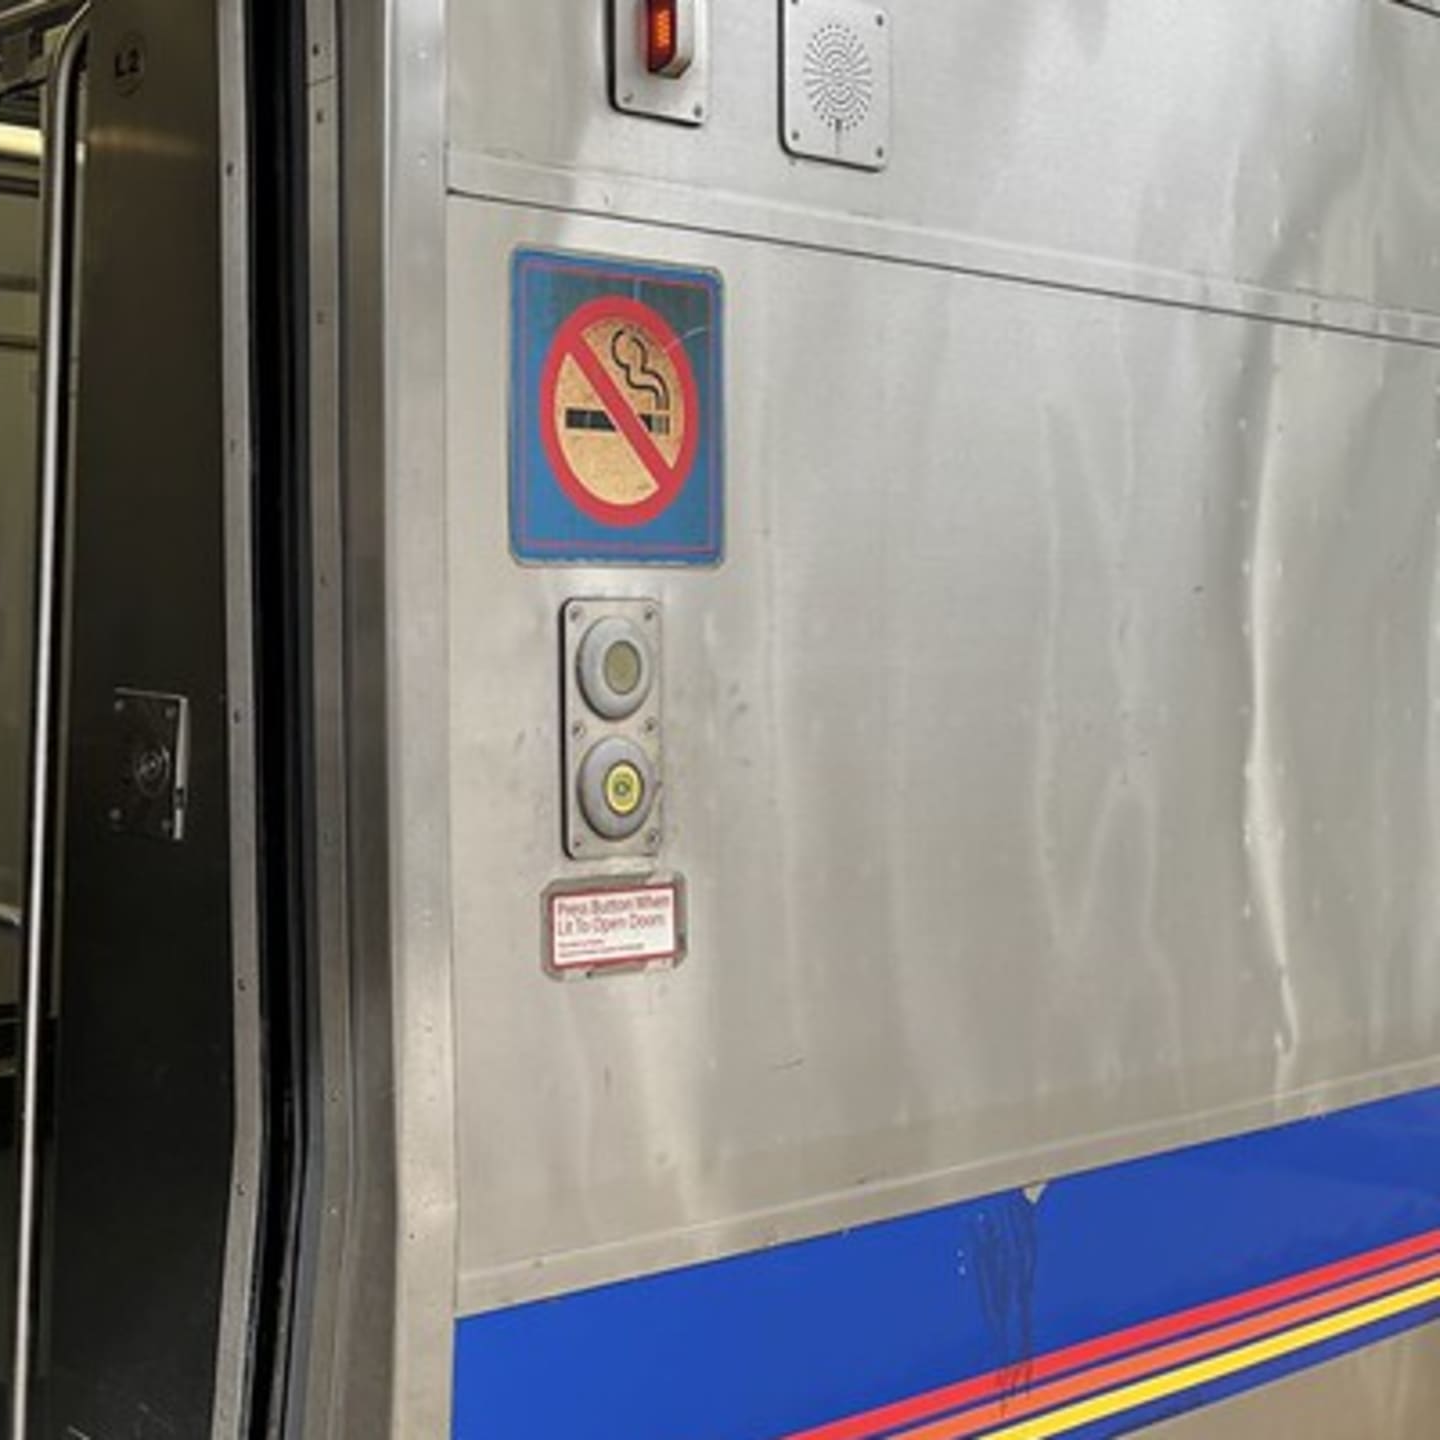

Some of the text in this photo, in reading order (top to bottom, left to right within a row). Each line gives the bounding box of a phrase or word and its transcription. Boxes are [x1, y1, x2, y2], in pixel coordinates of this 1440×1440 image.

[557, 895, 670, 916] Press Button When
[557, 912, 666, 936] Lit To Open Doors
